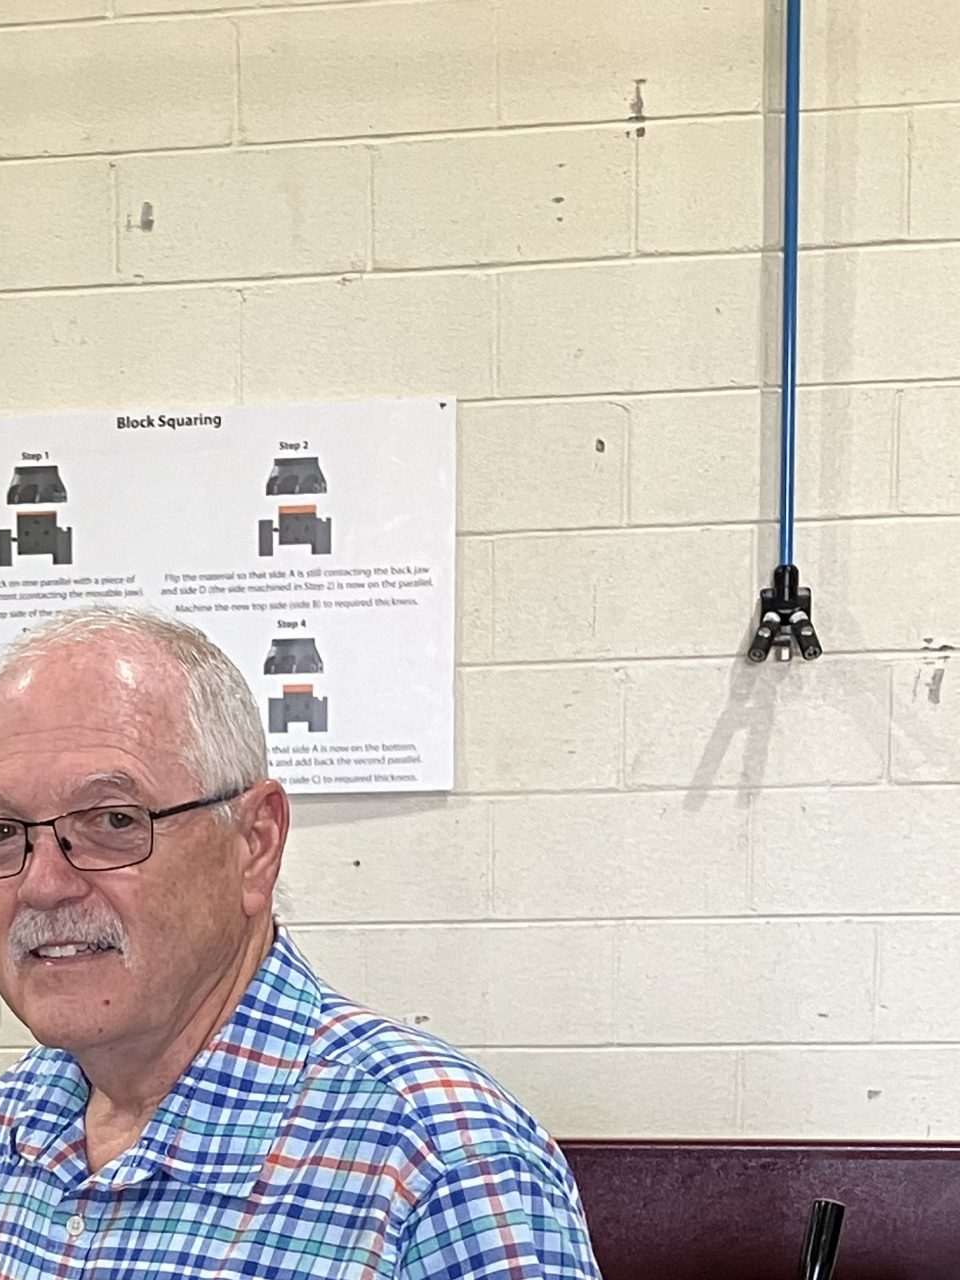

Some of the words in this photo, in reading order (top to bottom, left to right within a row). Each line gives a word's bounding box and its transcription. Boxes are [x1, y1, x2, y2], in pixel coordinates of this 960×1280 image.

[117, 416, 155, 429] Block
[158, 413, 222, 430] Squaring
[279, 441, 301, 451] Step
[303, 440, 309, 449] 2
[21, 452, 42, 461] Step
[277, 619, 299, 629] Step
